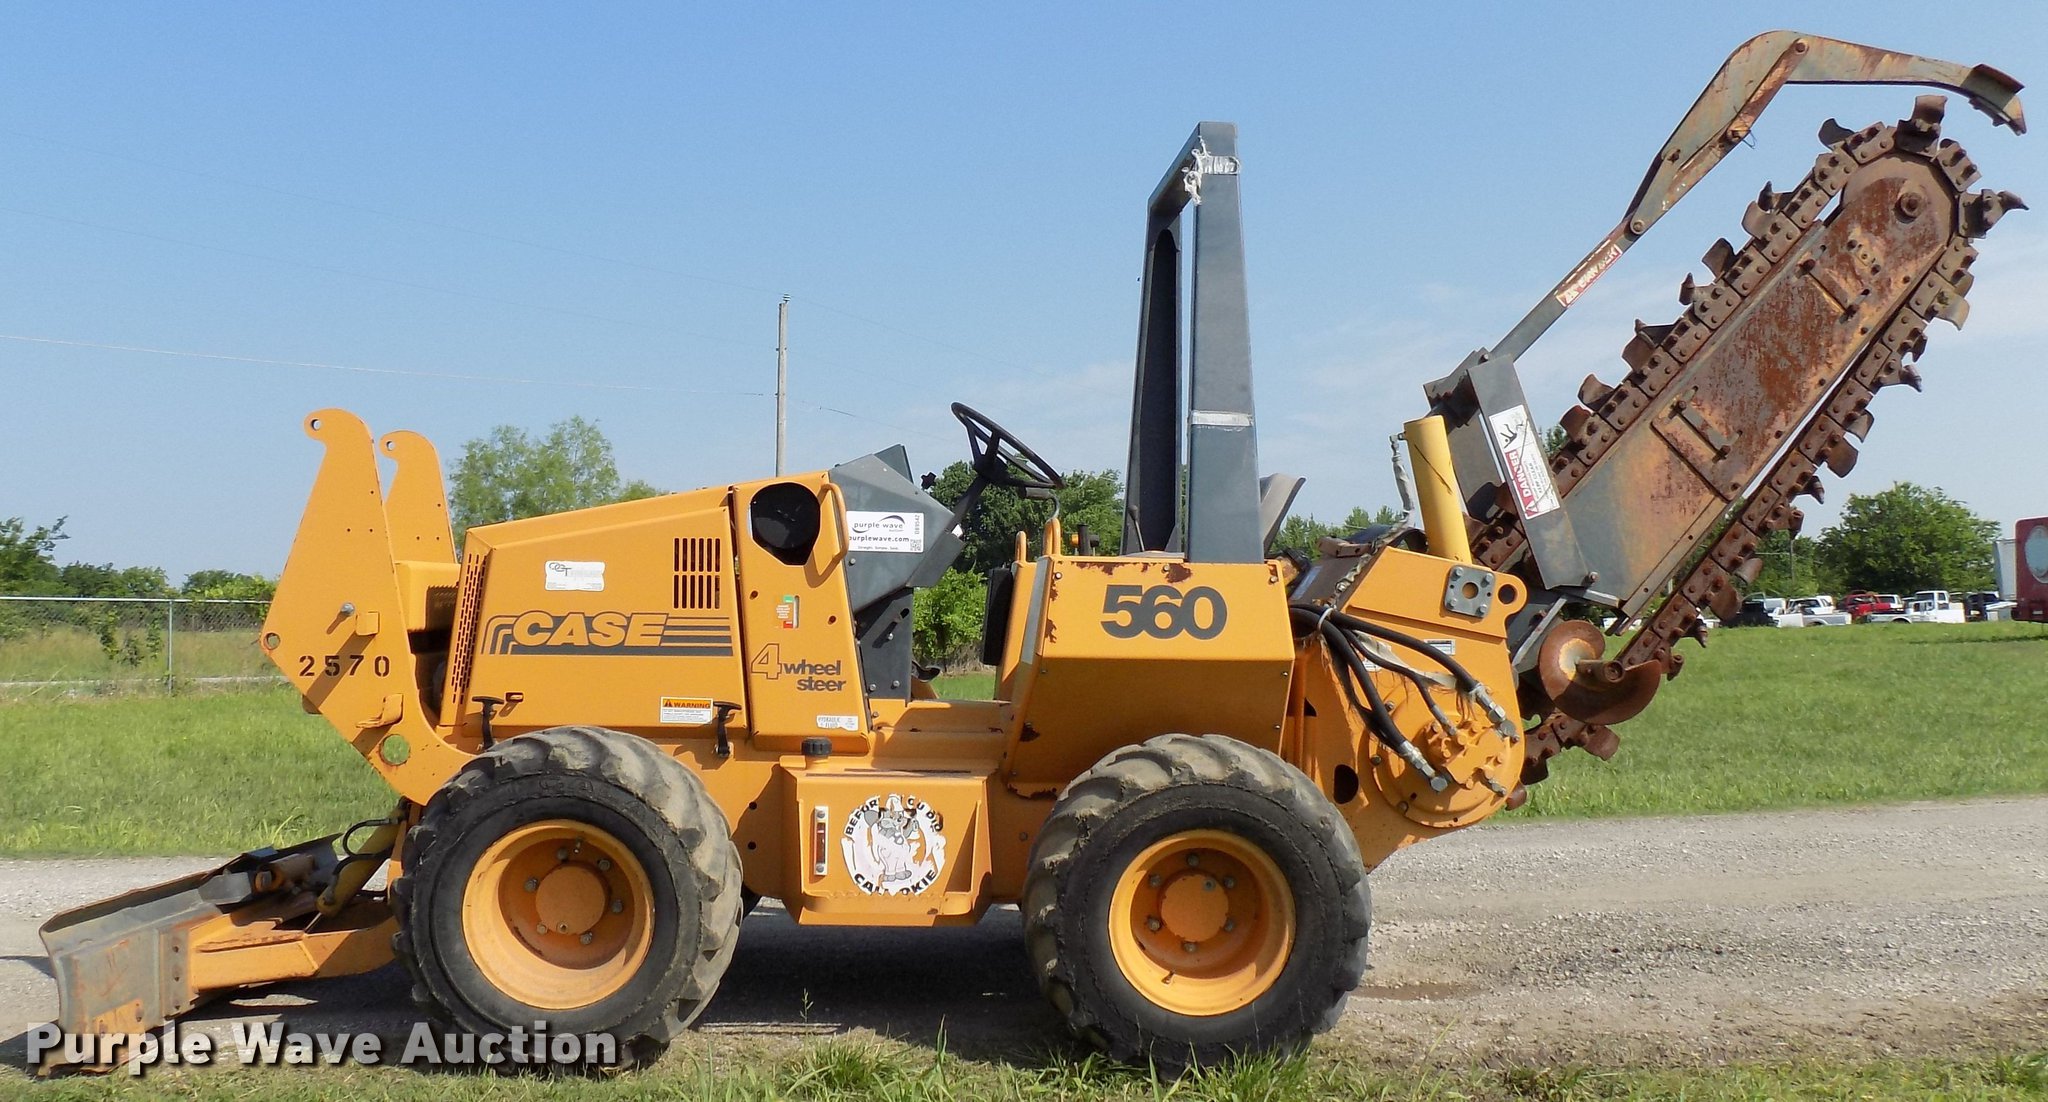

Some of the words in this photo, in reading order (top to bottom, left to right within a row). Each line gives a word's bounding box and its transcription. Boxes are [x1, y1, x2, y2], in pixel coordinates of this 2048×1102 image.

[1508, 449, 1533, 498] DANGER
[854, 521, 880, 529] purple
[513, 610, 669, 647] CASE
[1100, 584, 1228, 640] 560
[299, 654, 390, 677] 2570
[751, 643, 782, 680] 4
[783, 659, 841, 675] wheel
[797, 677, 846, 691] steer
[674, 701, 711, 709] WARNING
[845, 797, 880, 836] BEFOR
